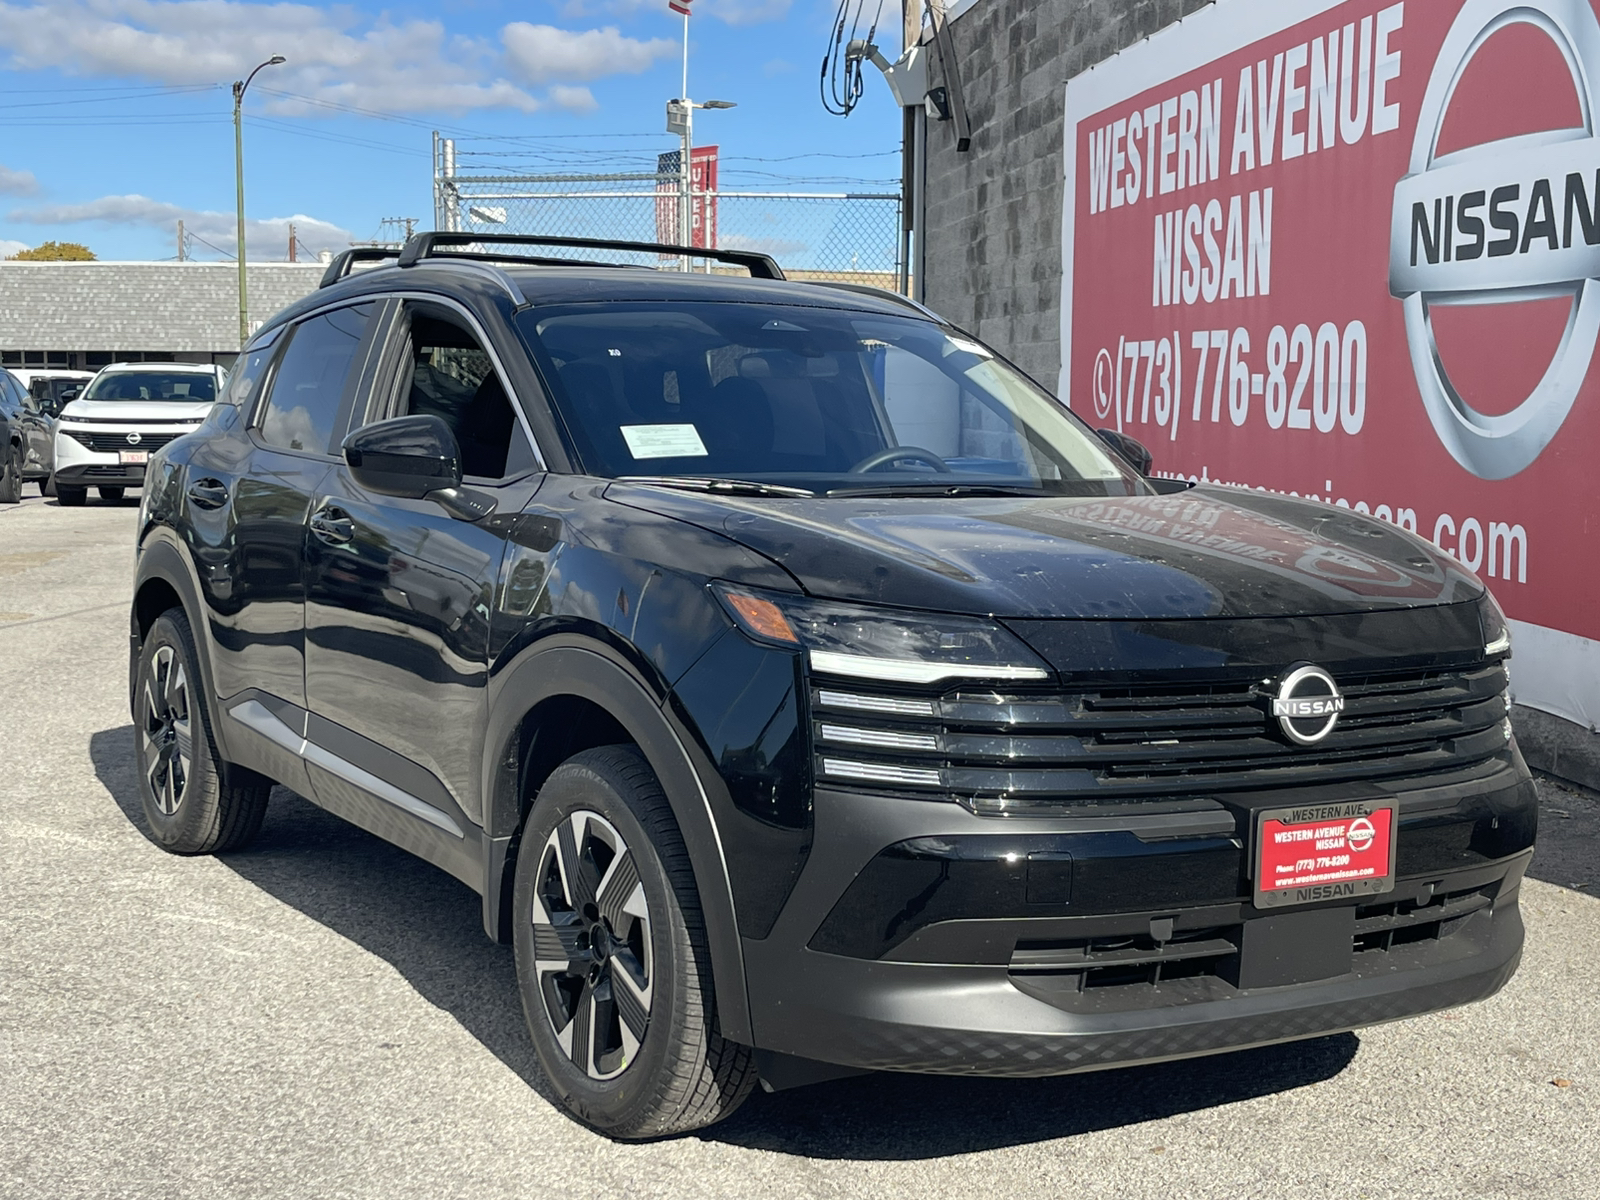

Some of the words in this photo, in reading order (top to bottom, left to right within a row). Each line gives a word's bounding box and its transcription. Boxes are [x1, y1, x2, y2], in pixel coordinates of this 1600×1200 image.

[1089, 78, 1222, 215] WESTERN
[1230, 2, 1404, 176] AVENUE
[1410, 168, 1600, 267] NISSAN
[1152, 187, 1274, 307] NISSAN
[1116, 331, 1182, 441] (773)
[1191, 320, 1367, 435] 776-8200
[1275, 698, 1344, 715] NISSAN
[1291, 805, 1342, 822] WESTERN
[1274, 829, 1314, 844] WESTERN
[1314, 825, 1346, 840] AVENUE
[1315, 837, 1345, 851] NISSAN
[1348, 831, 1374, 840] NISSAN
[1295, 858, 1315, 873] (773)
[1316, 854, 1350, 869] 776-8200
[1296, 883, 1355, 901] NISSAN
